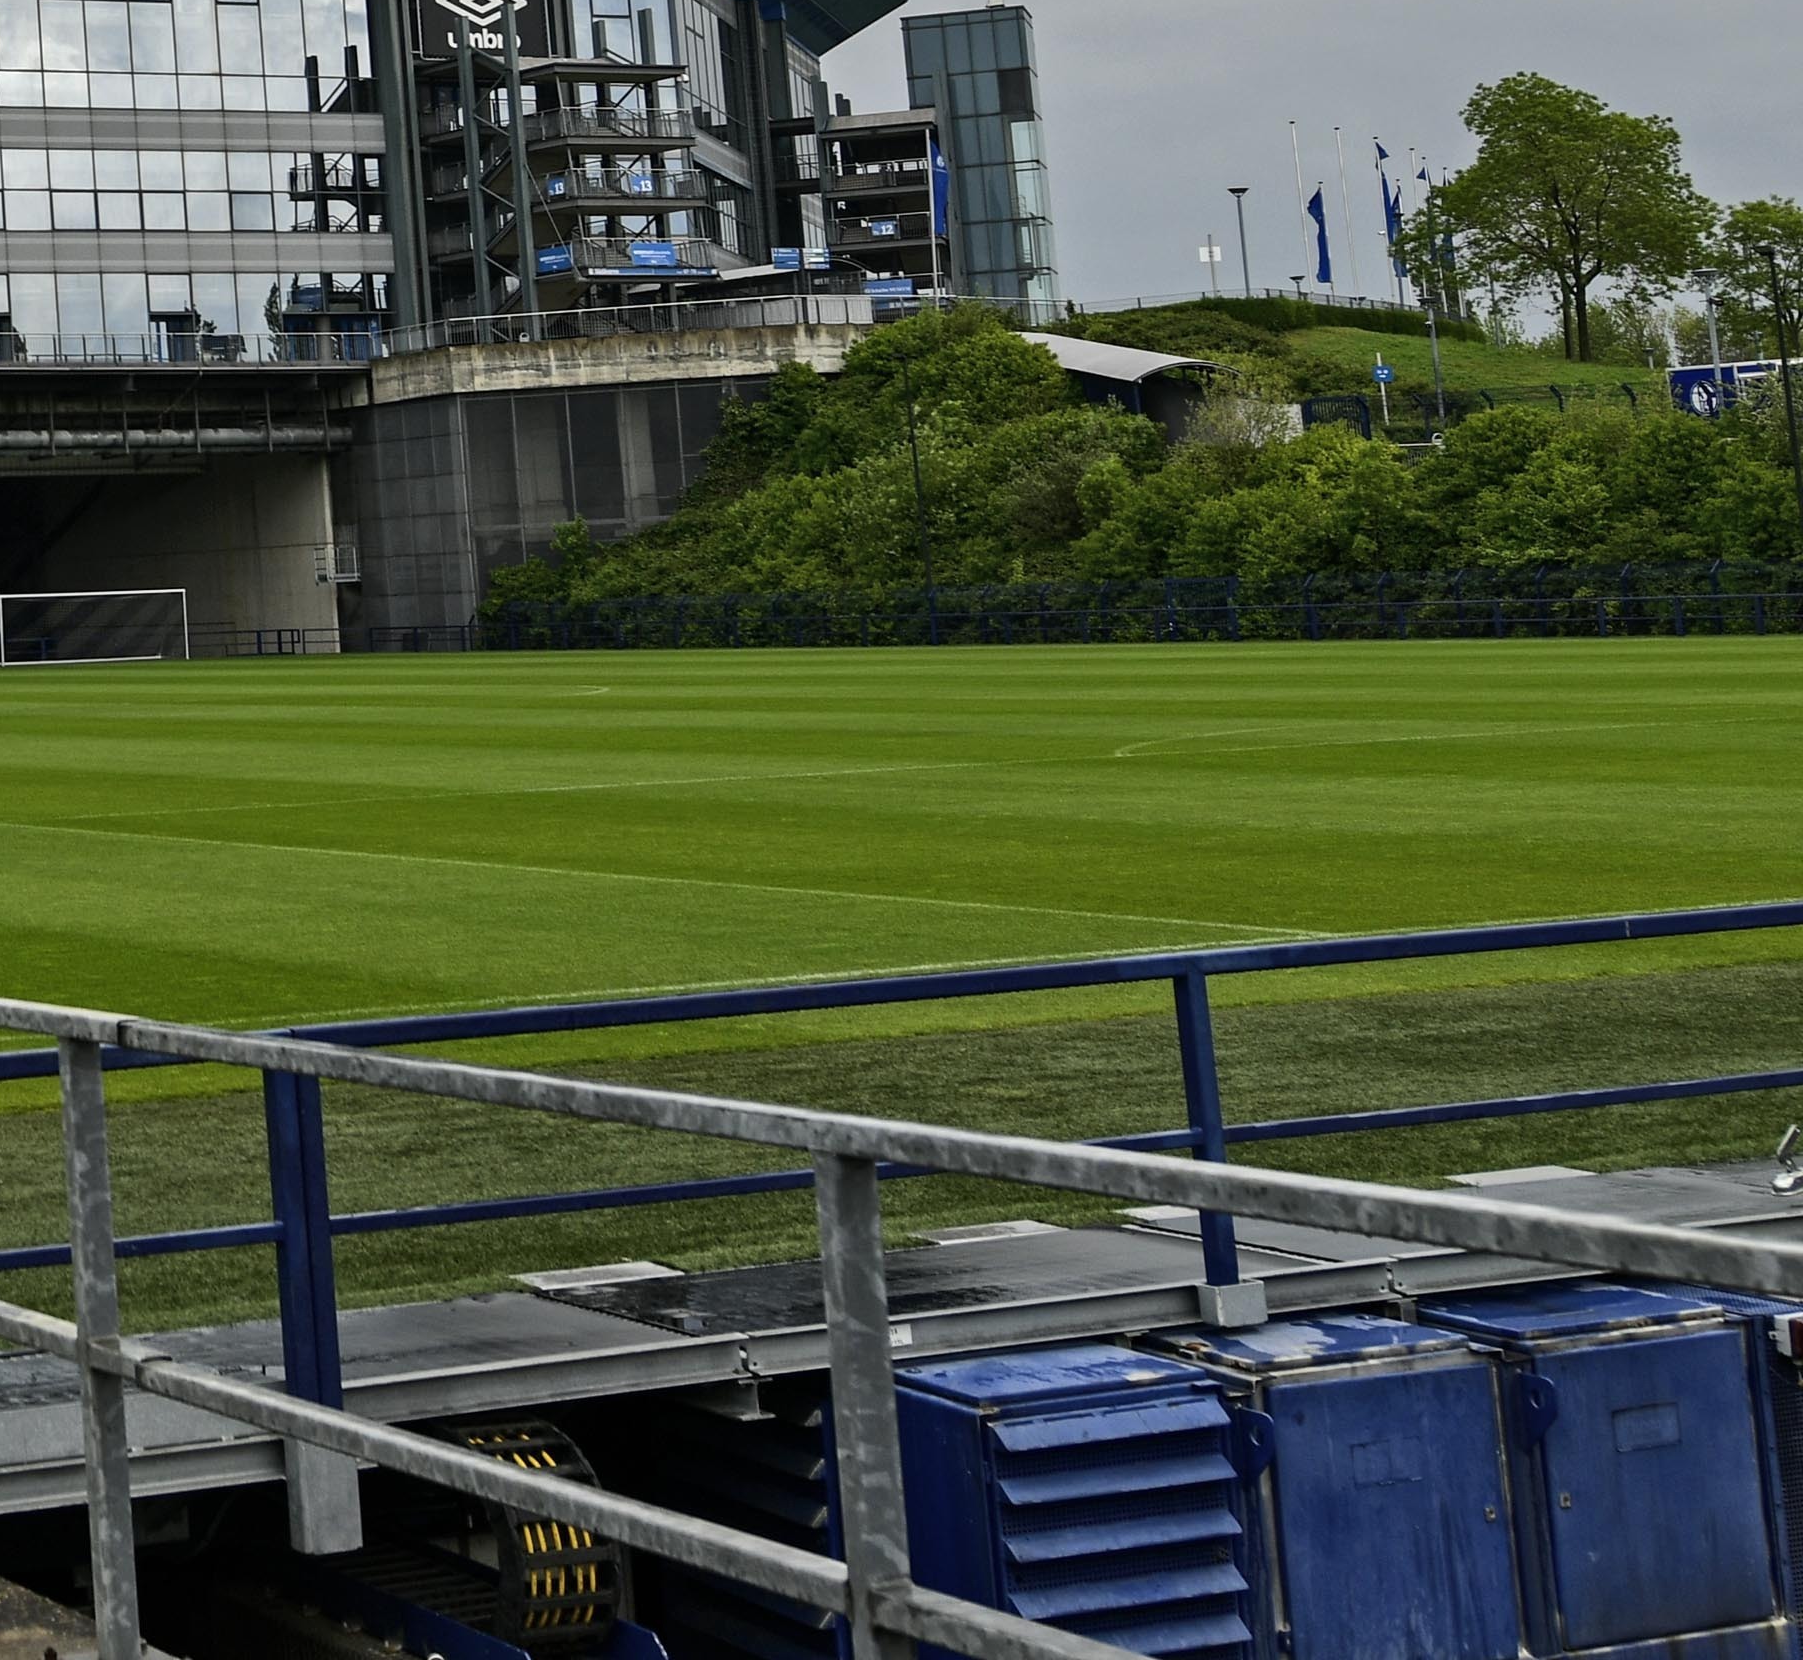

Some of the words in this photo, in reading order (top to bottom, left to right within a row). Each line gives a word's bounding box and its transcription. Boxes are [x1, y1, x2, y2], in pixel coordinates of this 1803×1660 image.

[555, 182, 564, 195] 13
[640, 180, 652, 192] 13
[880, 224, 895, 235] 12
